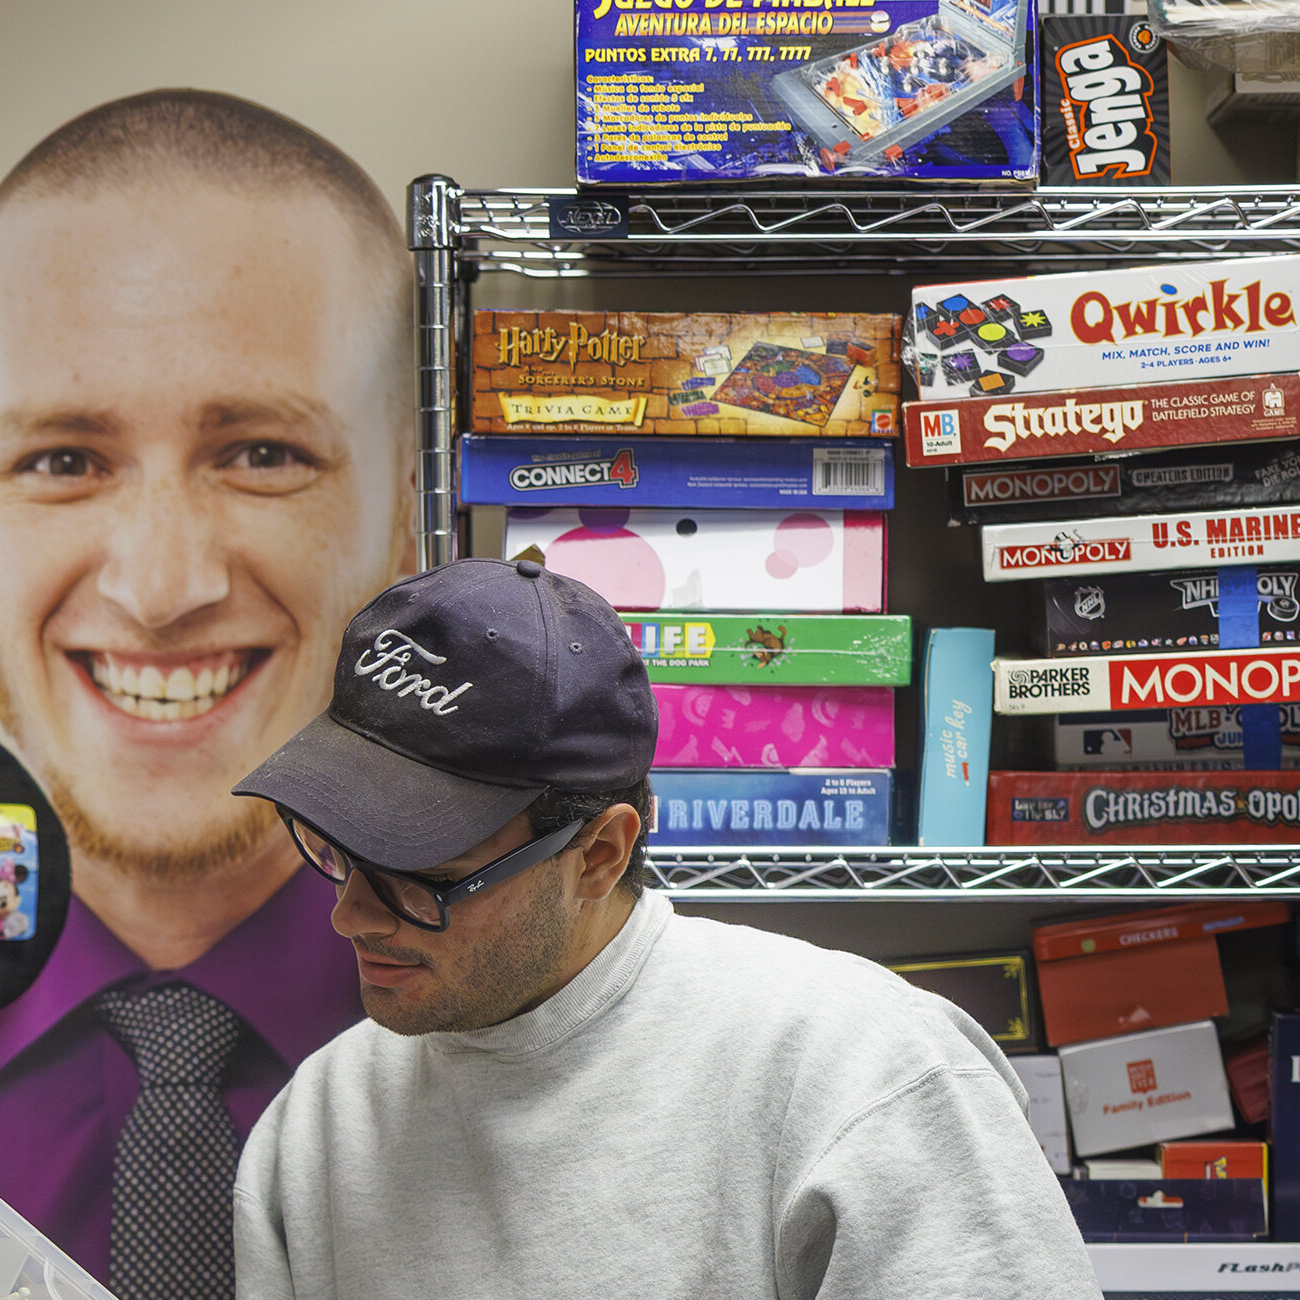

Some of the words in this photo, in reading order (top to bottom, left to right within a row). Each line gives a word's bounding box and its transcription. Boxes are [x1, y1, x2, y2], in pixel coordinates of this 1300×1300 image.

[615, 13, 713, 36] AVENTURA
[717, 13, 748, 35] DEL
[755, 12, 833, 35] ESPACIO
[585, 48, 647, 63] PUNTOS
[651, 48, 700, 62] EXTRA
[705, 47, 718, 63] 7,
[722, 47, 742, 63] 77,
[746, 46, 775, 62] 777,
[779, 46, 812, 61] 7777
[1061, 40, 1146, 175] Jenga
[1061, 98, 1081, 150] Classic
[1070, 278, 1297, 346] Qwirkle
[494, 326, 566, 368] Harry
[569, 321, 647, 374] Potter
[1102, 349, 1127, 363] MIX,
[1129, 345, 1171, 360] MATCH,
[1174, 342, 1212, 354] SCORE
[1215, 340, 1240, 352] AND
[1243, 338, 1271, 350] WIN!
[601, 376, 646, 388] STONE
[511, 403, 575, 416] TRIVIA
[582, 404, 633, 416] GAME
[1151, 399, 1168, 409] THE
[1170, 395, 1208, 407] CLASSIC
[1210, 392, 1240, 404] GAME
[1241, 391, 1255, 401] OF
[1152, 407, 1209, 422] BATTLEFIELD
[1210, 404, 1256, 417] STRATEGY
[984, 398, 1145, 453] Stratego
[511, 460, 612, 489] CONNECT
[609, 449, 636, 486] 4
[970, 470, 1115, 501] MONOPOLY
[1152, 522, 1200, 549] U.S.
[1002, 540, 1128, 568] MONOPOLY
[1210, 544, 1266, 560] EDITION
[640, 624, 712, 656] IFE
[354, 628, 473, 717] Ford
[1030, 667, 1090, 684] PARKER
[1009, 681, 1091, 699] BROTHERS
[939, 729, 957, 779] music
[956, 731, 968, 759] car
[668, 798, 865, 831] RIVERDALE
[1103, 1099, 1144, 1116] Family
[1147, 1090, 1192, 1109] Edition
